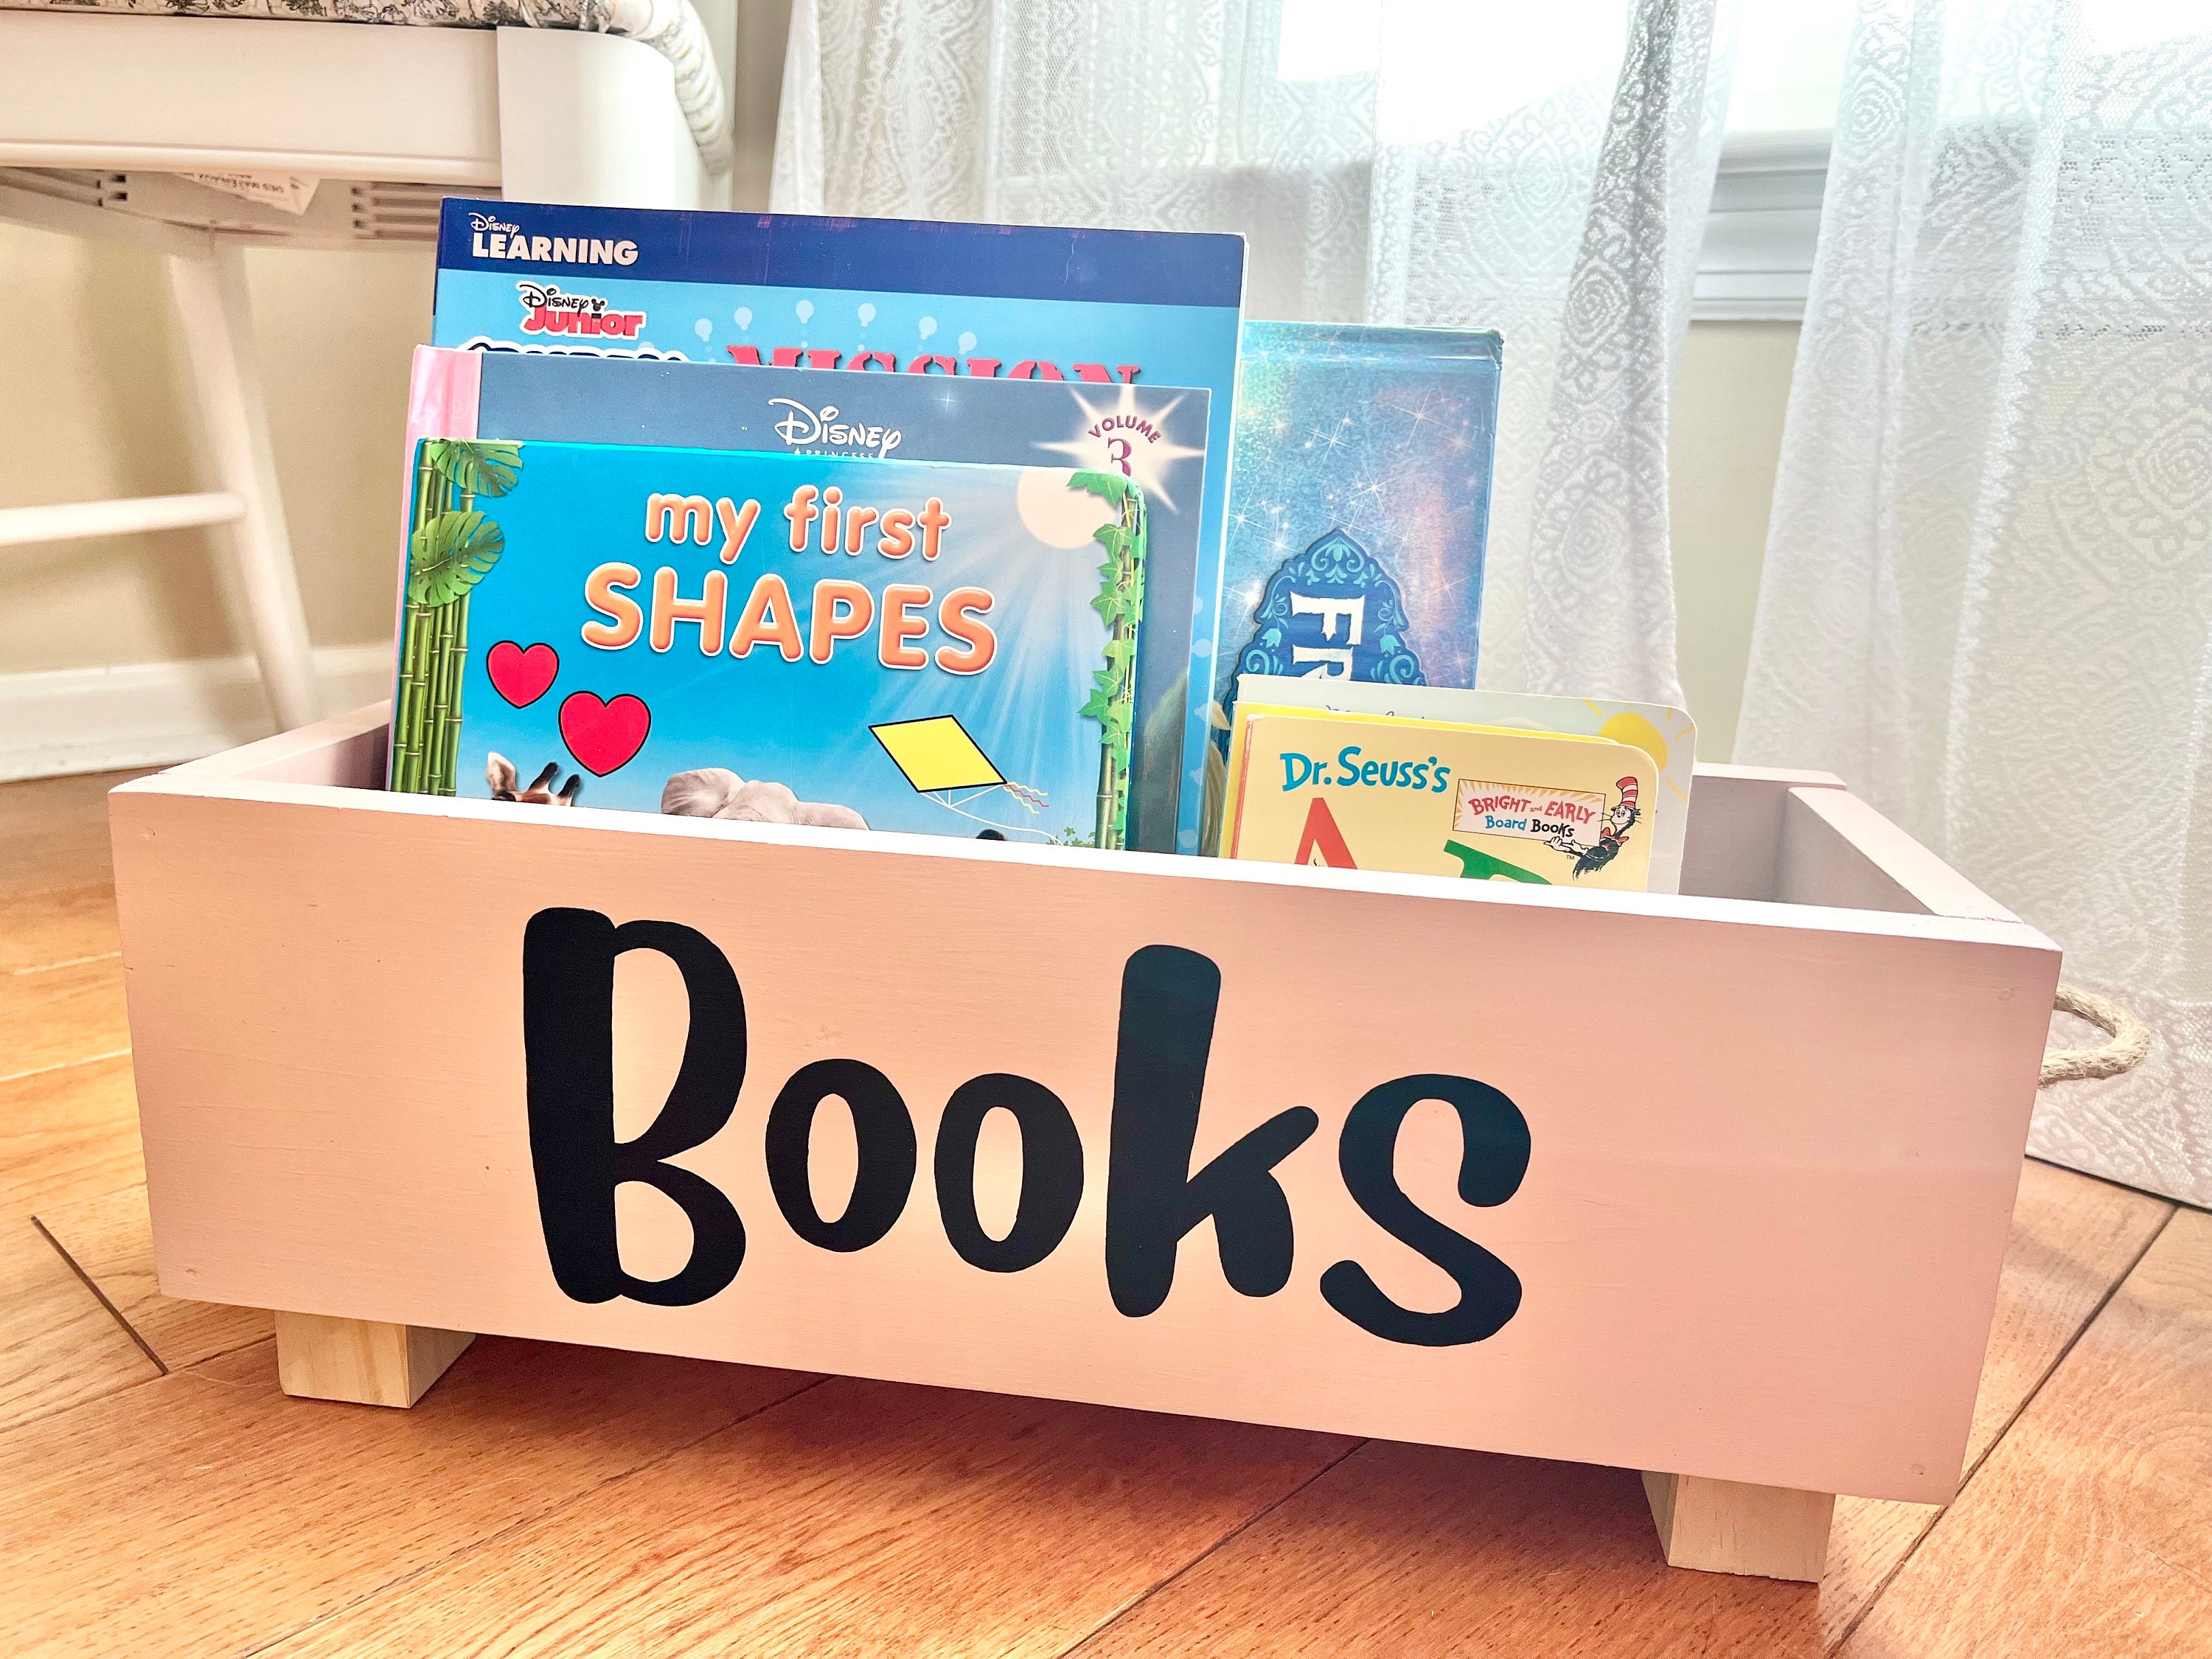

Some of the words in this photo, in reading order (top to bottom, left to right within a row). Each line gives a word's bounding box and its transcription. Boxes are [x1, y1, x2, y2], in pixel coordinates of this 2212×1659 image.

[468, 212, 520, 237] Disney
[472, 233, 639, 266] LEARNING
[518, 283, 590, 314] Disney
[524, 305, 644, 337] Junior
[768, 397, 902, 459] Disney
[1088, 414, 1161, 444] VOLUME
[1107, 437, 1132, 477] 3
[645, 493, 761, 565] my
[785, 484, 951, 561] first
[581, 562, 998, 676] SHAPES
[1279, 752, 1330, 792] Dr.
[1336, 746, 1451, 793] Seuss's
[1467, 795, 1531, 815] BRIGHT
[1544, 801, 1596, 824] EARLY
[1484, 815, 1527, 832] Board
[523, 906, 1531, 1347] Books
